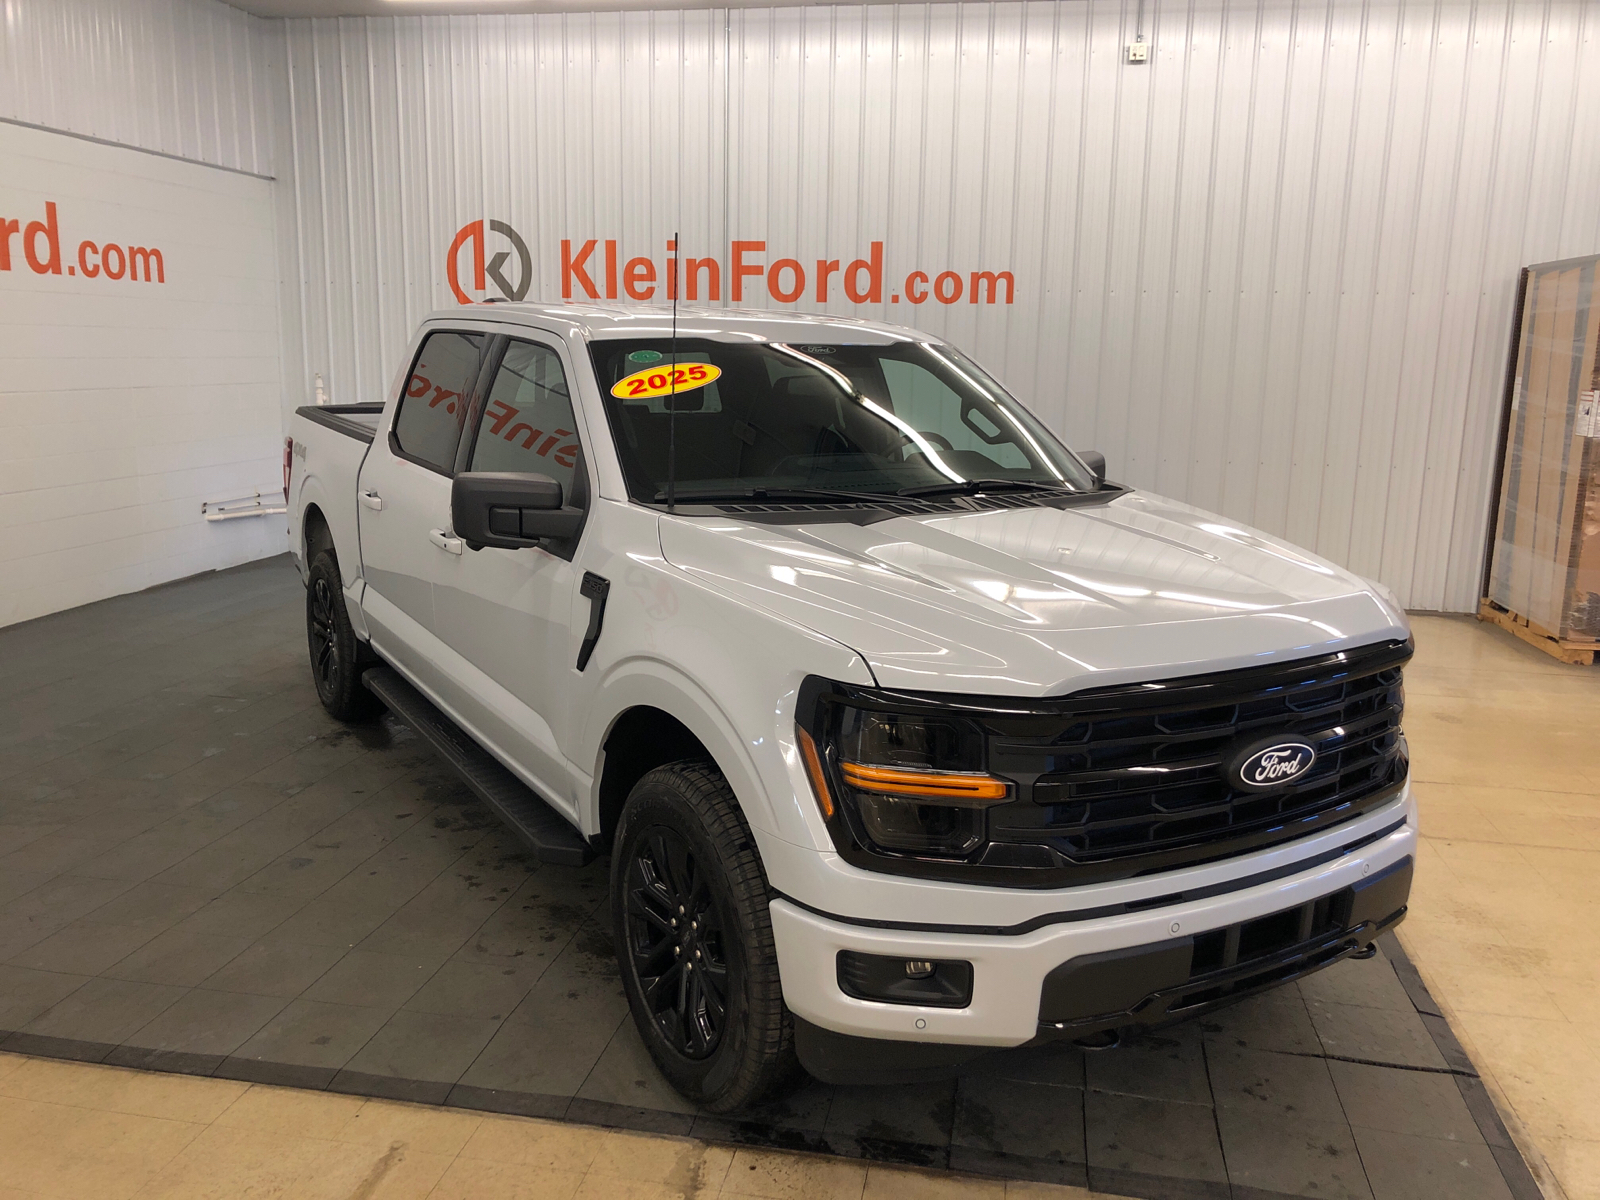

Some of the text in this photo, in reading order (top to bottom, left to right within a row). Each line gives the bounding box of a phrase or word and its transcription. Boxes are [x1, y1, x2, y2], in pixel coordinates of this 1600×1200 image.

[0, 201, 165, 283] rd.com
[560, 239, 1015, 304] KleinFord.com
[807, 345, 831, 353] Ford
[626, 365, 708, 396] 2025
[1254, 749, 1303, 781] Ford
